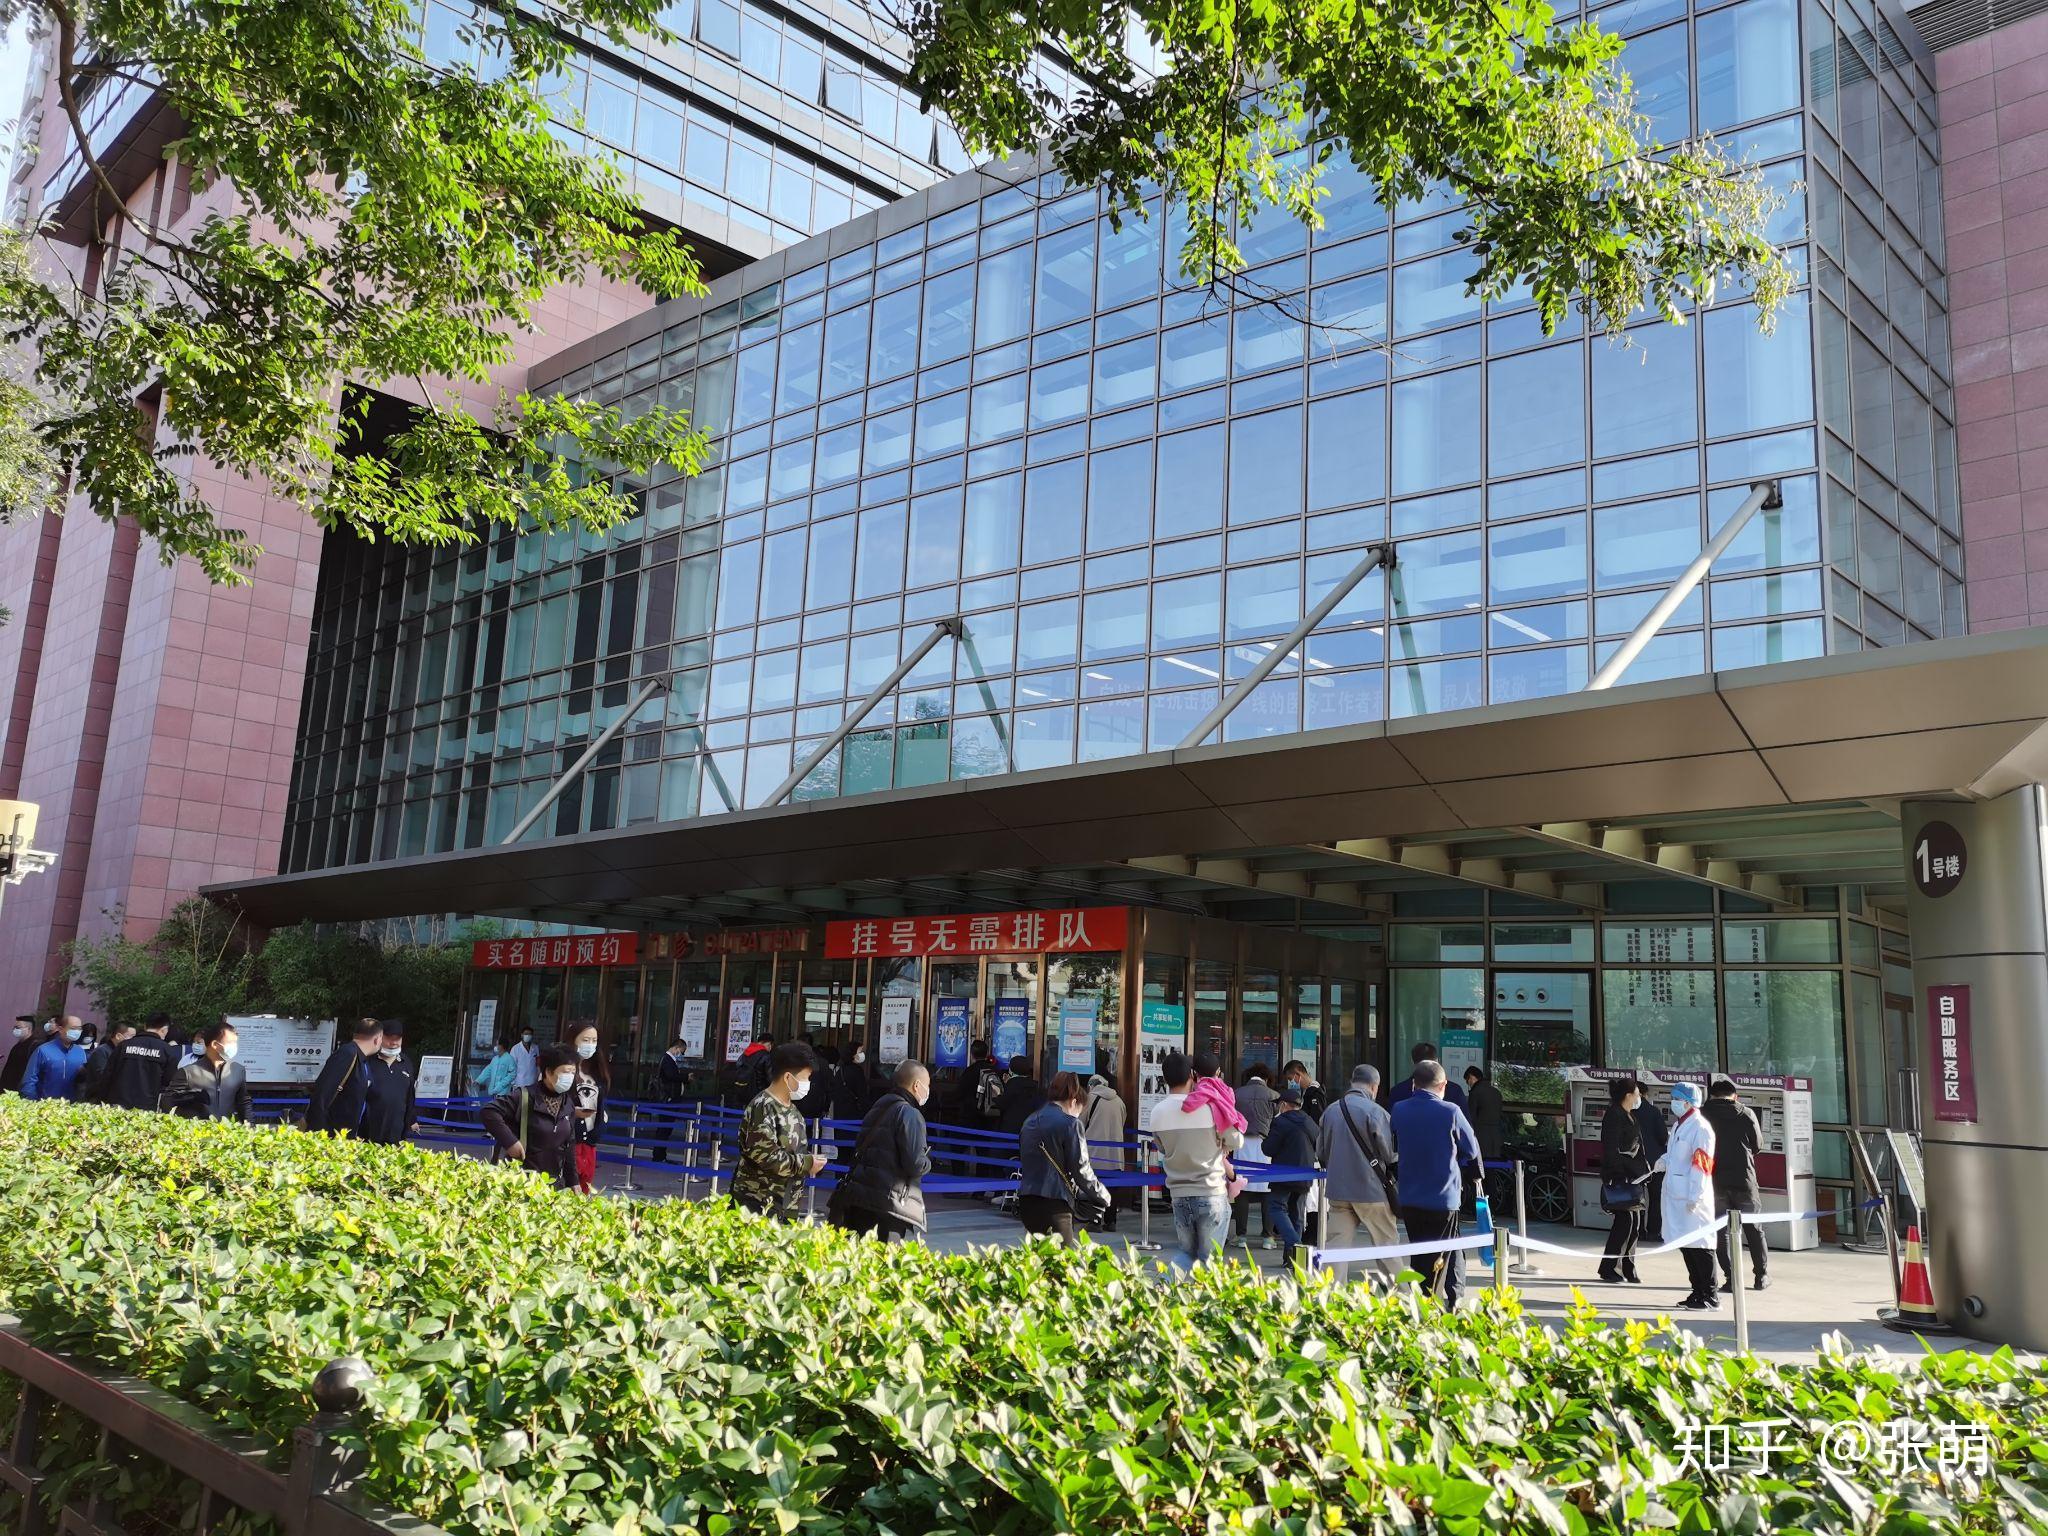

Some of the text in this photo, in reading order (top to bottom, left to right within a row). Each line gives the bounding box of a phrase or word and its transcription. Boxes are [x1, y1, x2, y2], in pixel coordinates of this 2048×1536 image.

[1916, 839, 1960, 883] 1号楼
[851, 912, 1092, 954] 挂号无需排队
[487, 937, 621, 967] 实名随时预约
[1939, 996, 1960, 1102] 自助服务区
[1590, 1070, 1633, 1080] 门诊自助服务机
[1660, 1073, 1705, 1083] 门诊自助服务机
[1736, 1076, 1784, 1087] 门诊自助服务机
